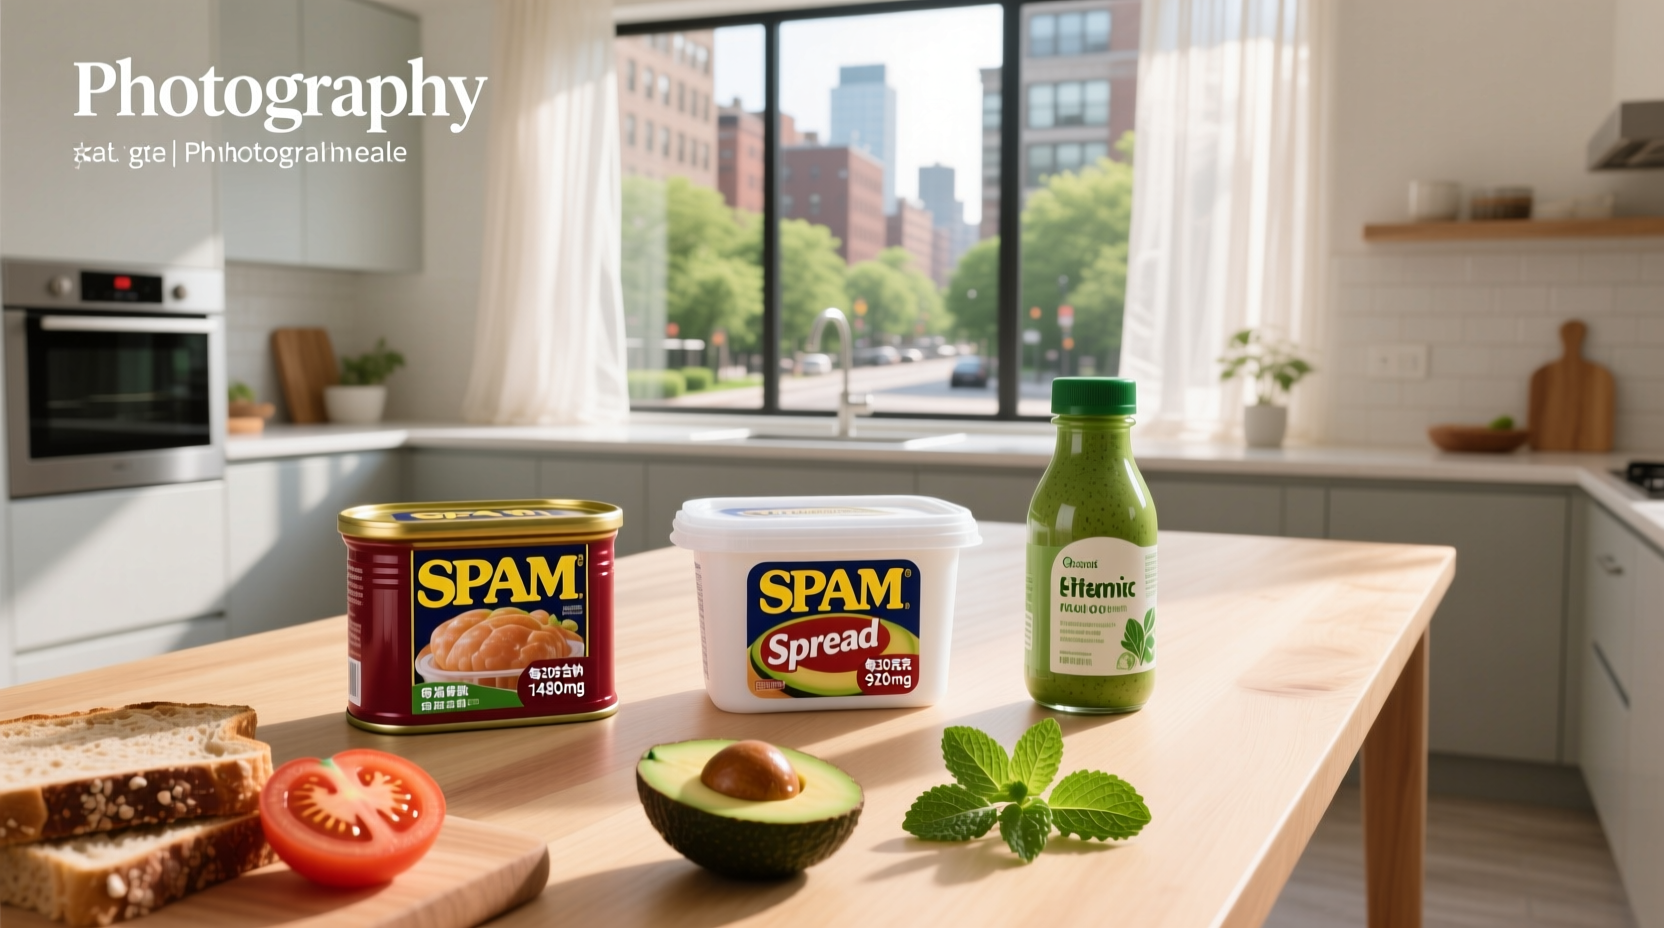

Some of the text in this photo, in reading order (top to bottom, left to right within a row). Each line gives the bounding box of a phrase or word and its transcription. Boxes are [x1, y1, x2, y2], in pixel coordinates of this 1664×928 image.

[417, 554, 578, 608] SPAM
[759, 567, 905, 614] SPAM
[767, 617, 880, 671] Spread
